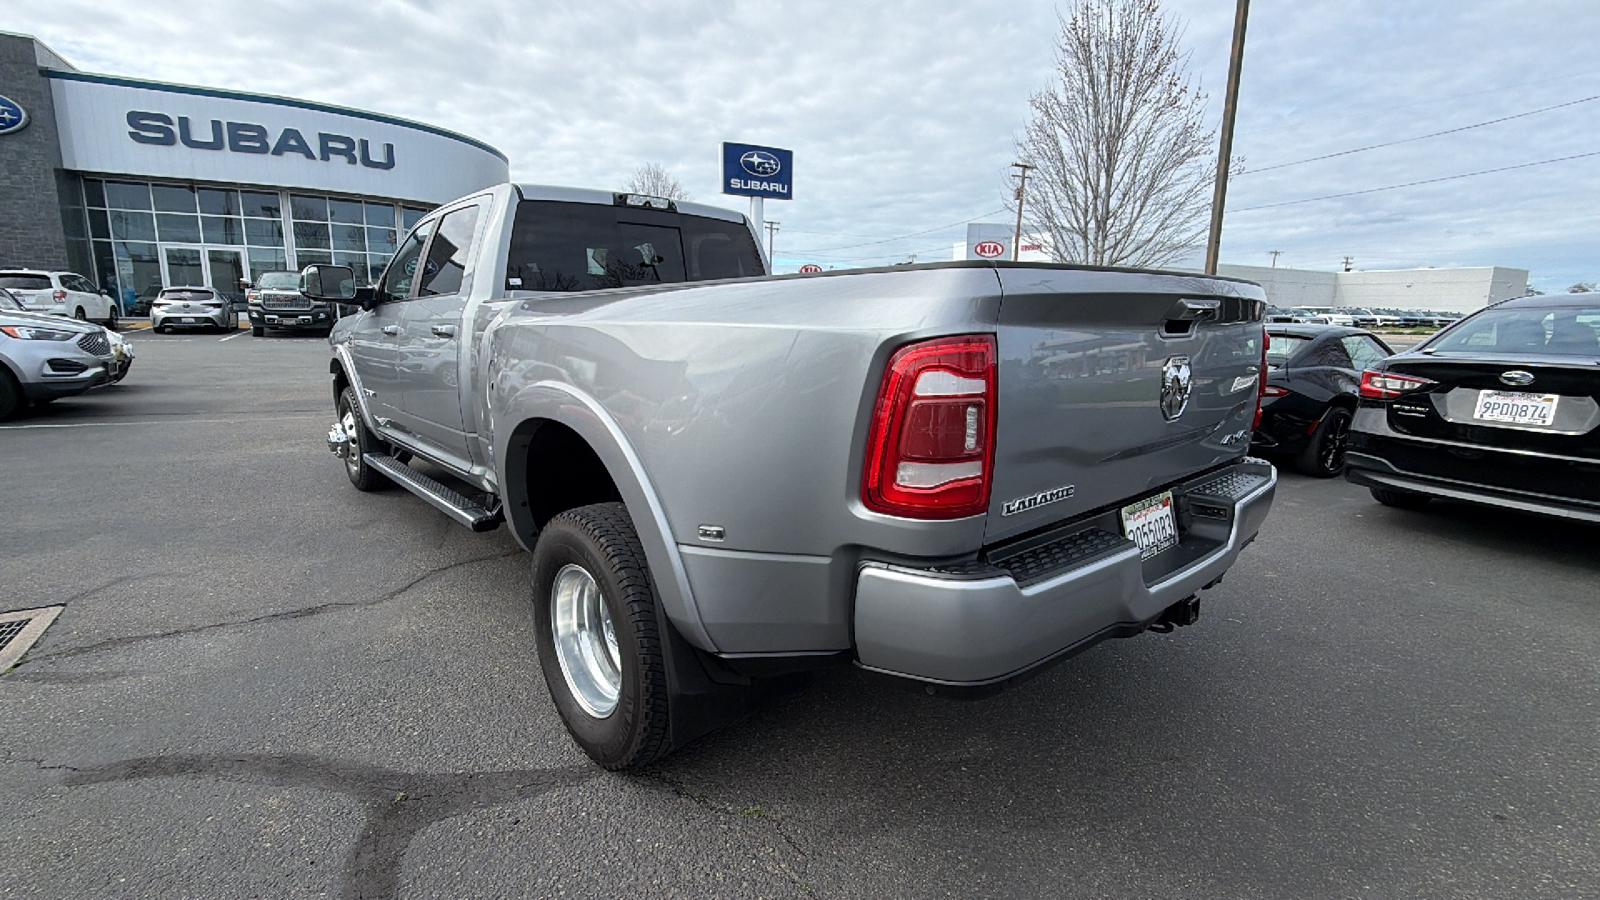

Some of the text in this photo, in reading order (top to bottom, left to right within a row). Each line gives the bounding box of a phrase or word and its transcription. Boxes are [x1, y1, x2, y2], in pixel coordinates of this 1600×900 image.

[126, 110, 396, 171] SUBARU
[730, 178, 788, 194] SUBARU
[979, 244, 1000, 255] KIA
[1002, 485, 1075, 516] LARAMIE
